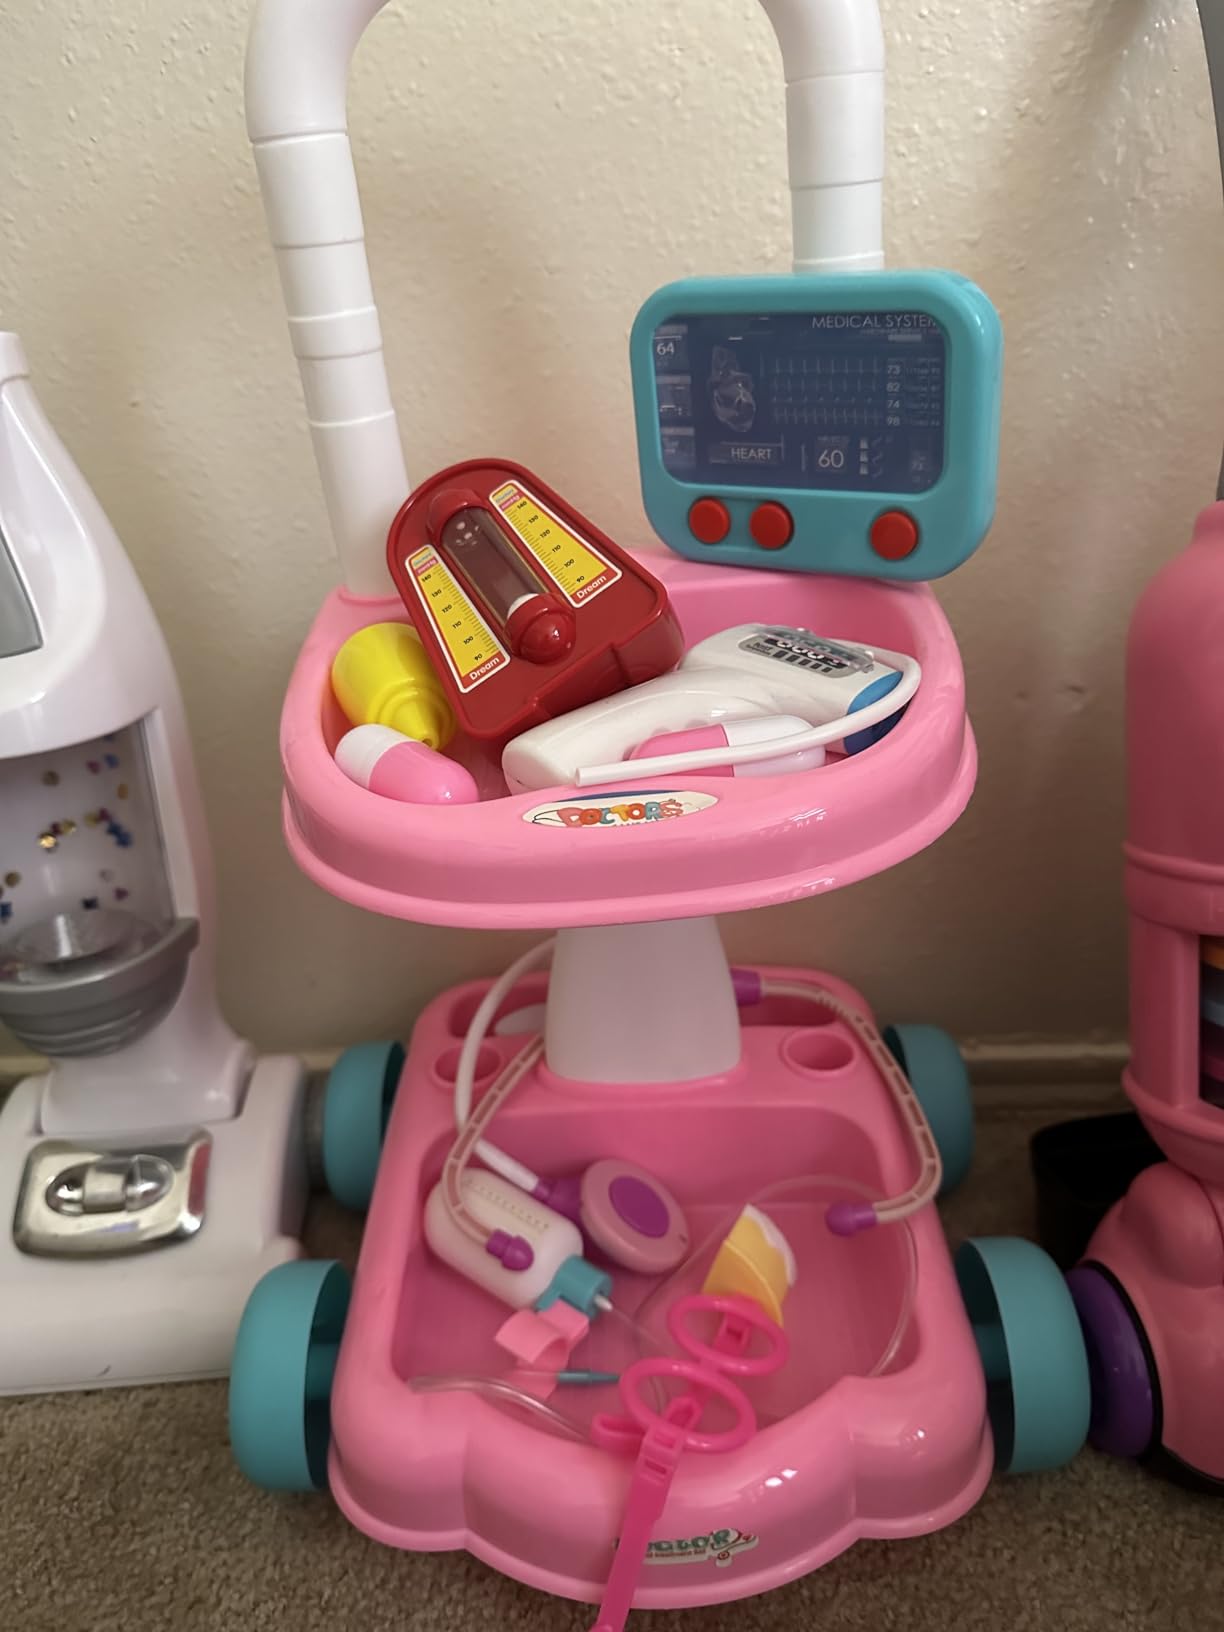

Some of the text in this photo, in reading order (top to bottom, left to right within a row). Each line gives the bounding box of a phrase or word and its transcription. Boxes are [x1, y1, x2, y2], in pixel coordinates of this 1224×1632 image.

[812, 315, 882, 329] MEDICAL
[656, 342, 675, 355] 64
[887, 400, 900, 409] 74
[731, 448, 772, 460] HEART
[818, 450, 844, 468] 60
[528, 515, 539, 524] 130
[540, 529, 550, 538] 120
[552, 544, 562, 553] 110
[564, 559, 574, 568] 100
[576, 575, 585, 583] 90
[576, 575, 607, 599] Dream
[431, 589, 442, 598] 130
[441, 604, 453, 613] 120
[452, 621, 462, 629] 110
[463, 636, 474, 645] 100
[474, 653, 483, 661] 90
[469, 657, 500, 681] Dream
[557, 801, 684, 827] DOCTORS
